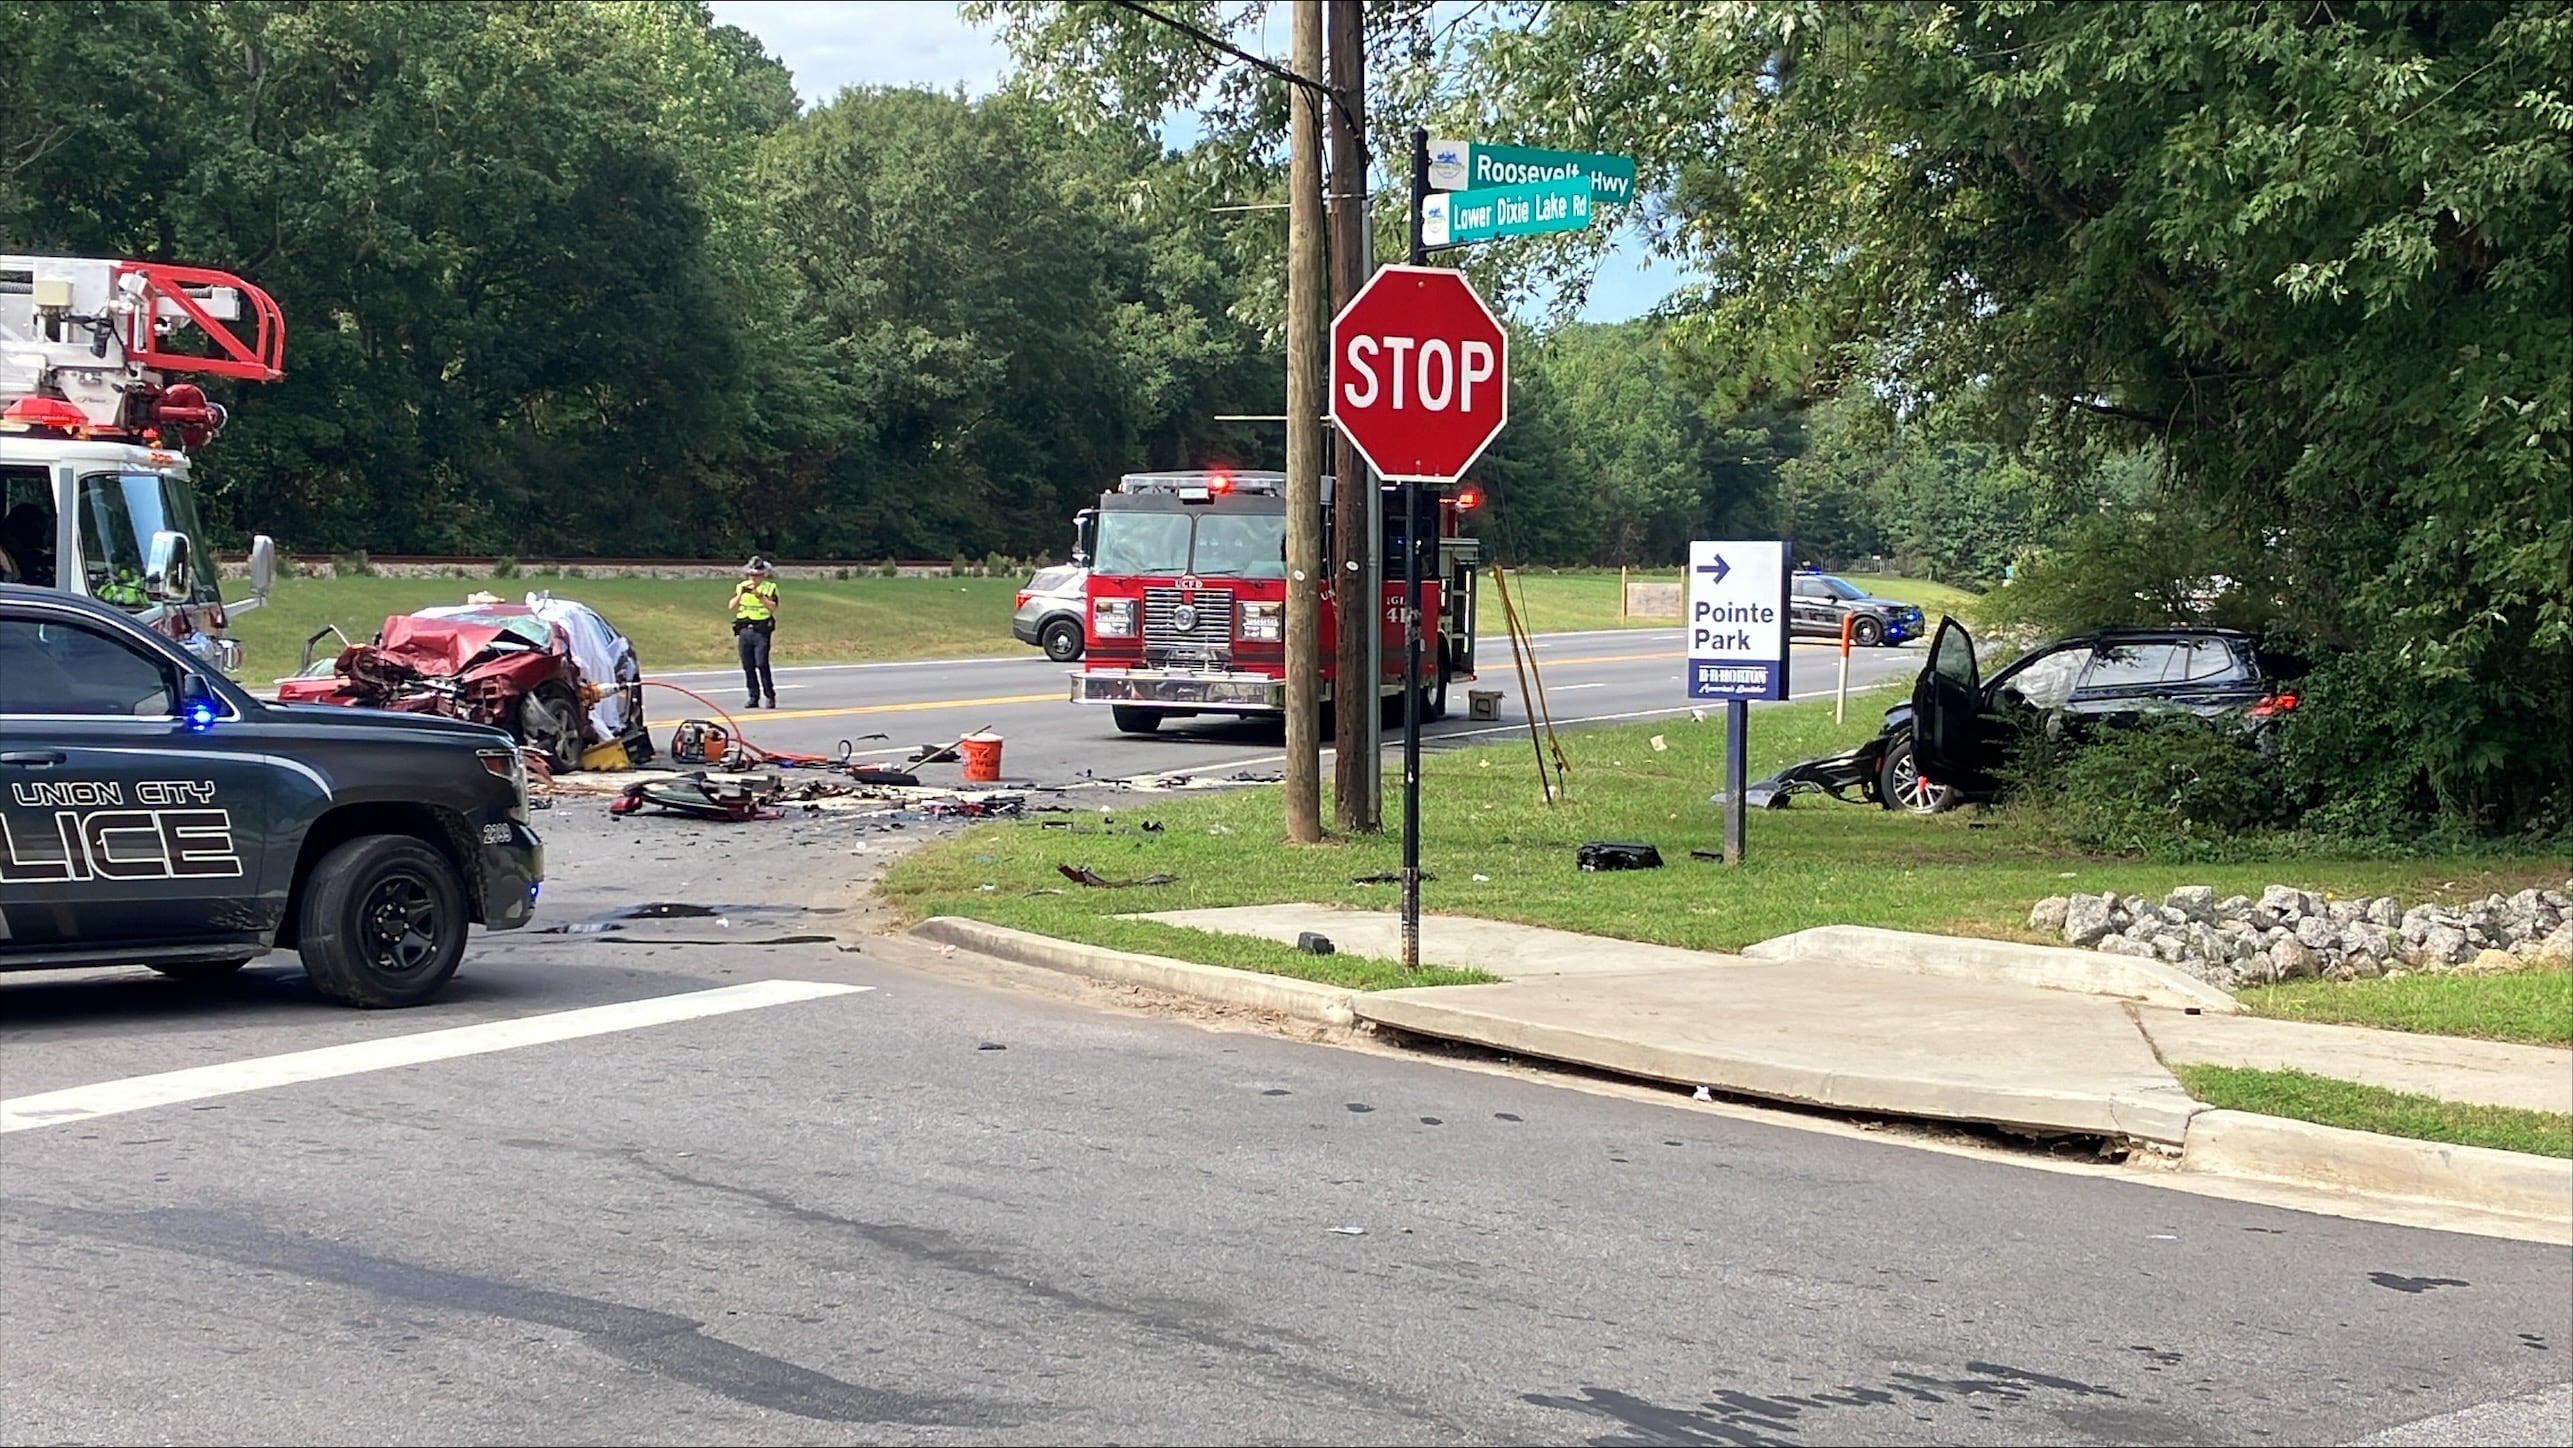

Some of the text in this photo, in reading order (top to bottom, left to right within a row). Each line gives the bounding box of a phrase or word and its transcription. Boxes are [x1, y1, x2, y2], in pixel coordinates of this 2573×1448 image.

[1477, 154, 1580, 183] Roosevelt
[1590, 172, 1629, 196] Hwy
[1454, 194, 1587, 230] Lower Dixie Lake Rd
[1344, 334, 1495, 412] STOP
[1695, 601, 1774, 623] Pointe
[1695, 629, 1751, 650] Park
[12, 781, 215, 806] UNION CITY
